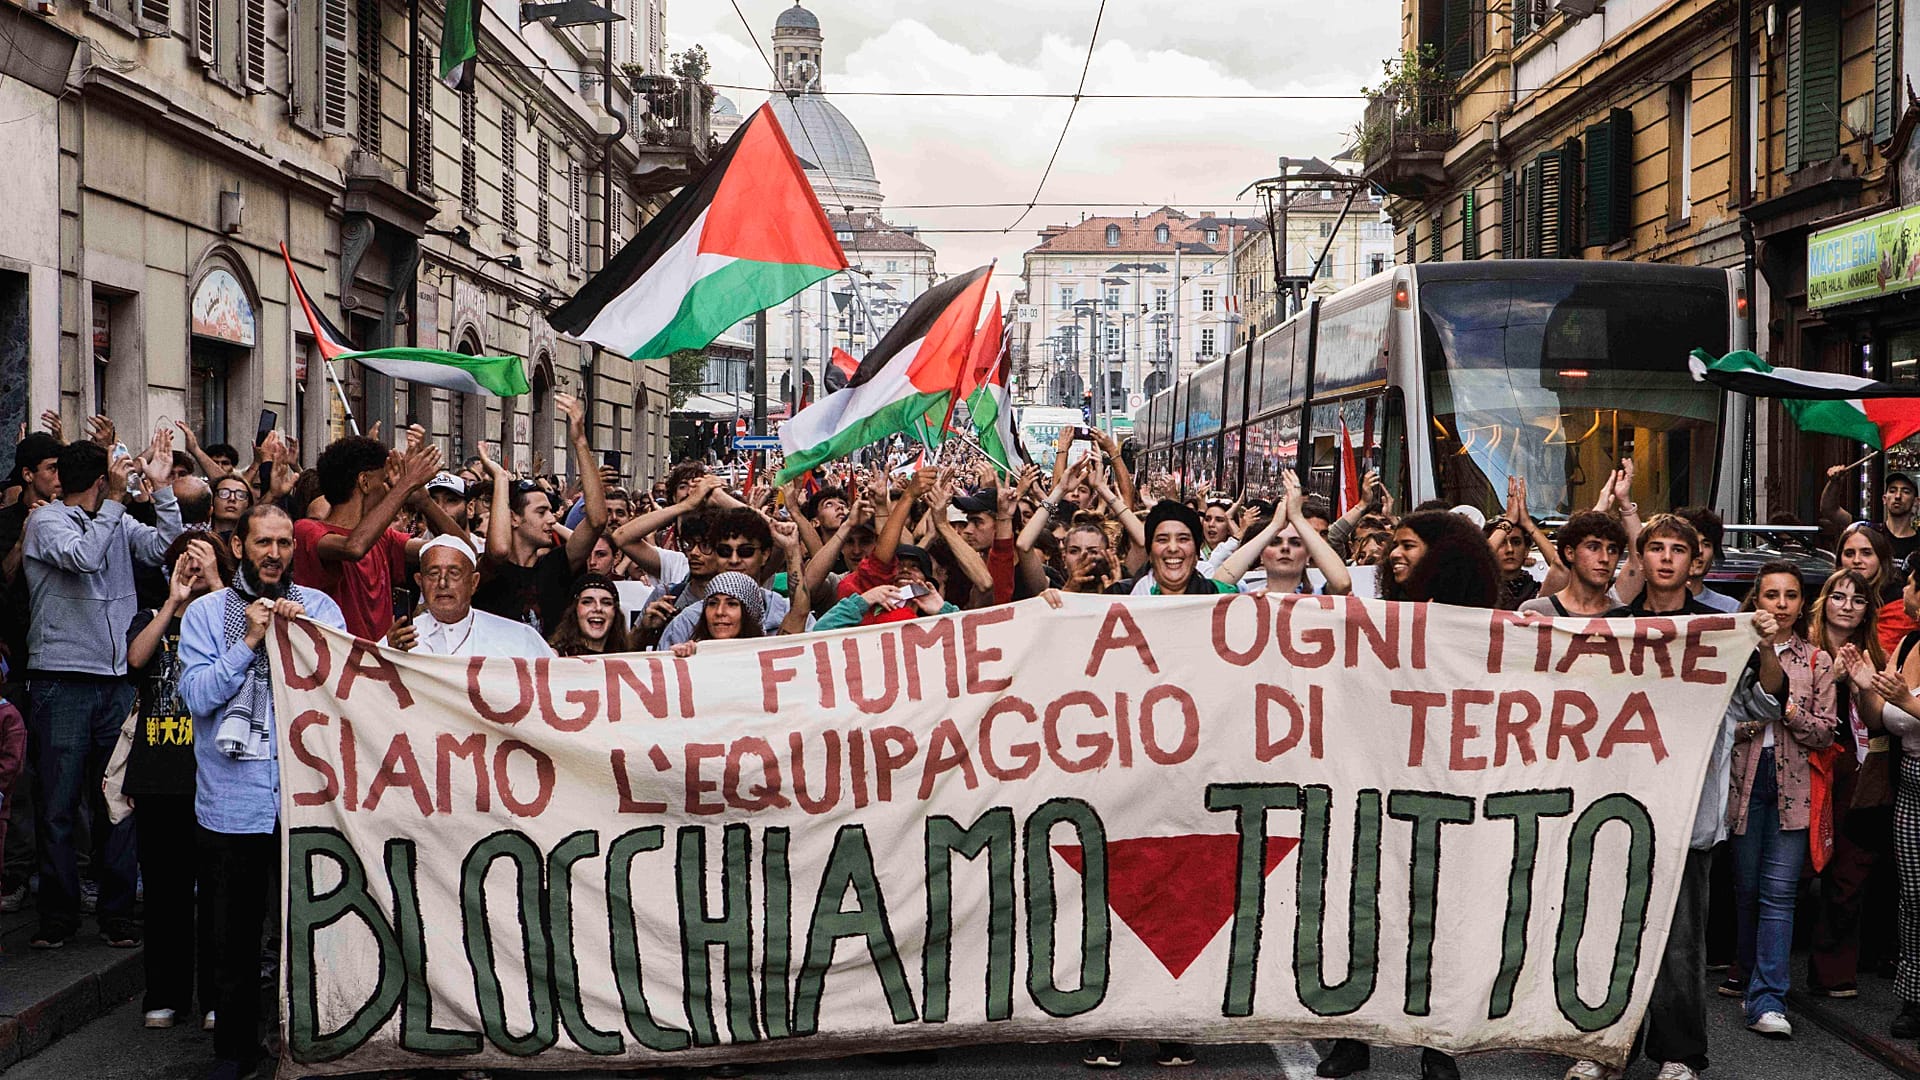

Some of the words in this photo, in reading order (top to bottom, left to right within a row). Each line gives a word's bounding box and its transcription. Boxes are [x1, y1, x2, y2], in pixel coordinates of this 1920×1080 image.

[1809, 231, 1877, 277] MACELLERIA
[274, 614, 415, 710] DA
[758, 606, 1015, 714] FIUME
[1085, 602, 1160, 677] A
[1211, 593, 1428, 669] OGNI
[1486, 608, 1736, 685] MARE
[289, 708, 556, 818] SIAMO
[610, 683, 1200, 815] L'EQUIPAGGIO
[1255, 683, 1324, 763] DI
[1390, 689, 1670, 771] TERRA
[288, 797, 1112, 1064] BLOCCHIAMO
[1205, 782, 1656, 1032] TUTTO
